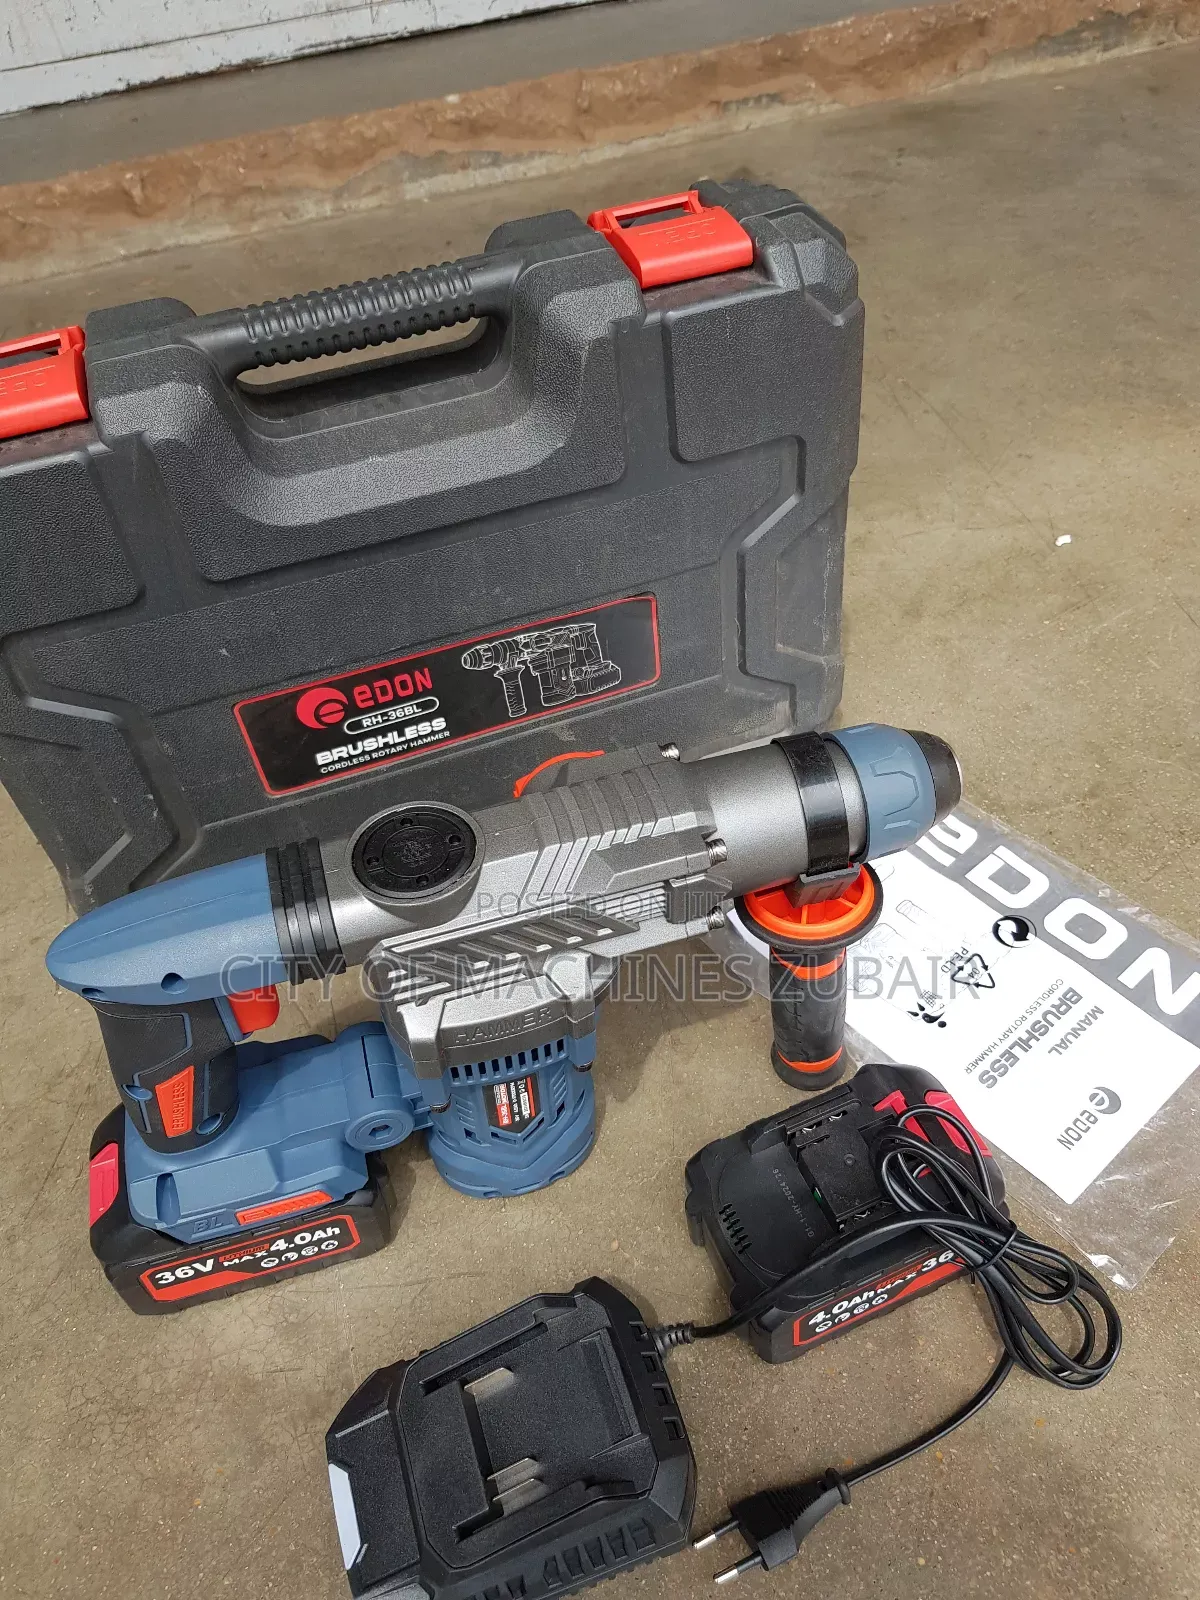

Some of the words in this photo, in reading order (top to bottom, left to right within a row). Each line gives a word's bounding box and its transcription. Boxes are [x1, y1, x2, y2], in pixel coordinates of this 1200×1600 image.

[362, 704, 422, 728] RH-36BL
[316, 717, 447, 766] BRUSHLESS
[320, 753, 371, 774] CORDLESS
[372, 744, 408, 759] ROTARY
[410, 731, 451, 748] HAMMER
[1025, 978, 1064, 1016] CORDLESS
[455, 1007, 553, 1043] HAMMER
[978, 986, 1083, 1089] BRUSHLESS
[998, 1014, 1028, 1044] ROTARY
[1047, 1005, 1105, 1056] MANUAL
[964, 1041, 1000, 1075] HAMMER
[171, 1080, 187, 1130] BRUSHLESS
[193, 1216, 224, 1234] BL
[154, 1258, 215, 1284] 36V
[222, 1251, 269, 1267] MAX
[269, 1226, 341, 1252] 4.0Ah
[808, 1290, 875, 1325] 4.0Ah
